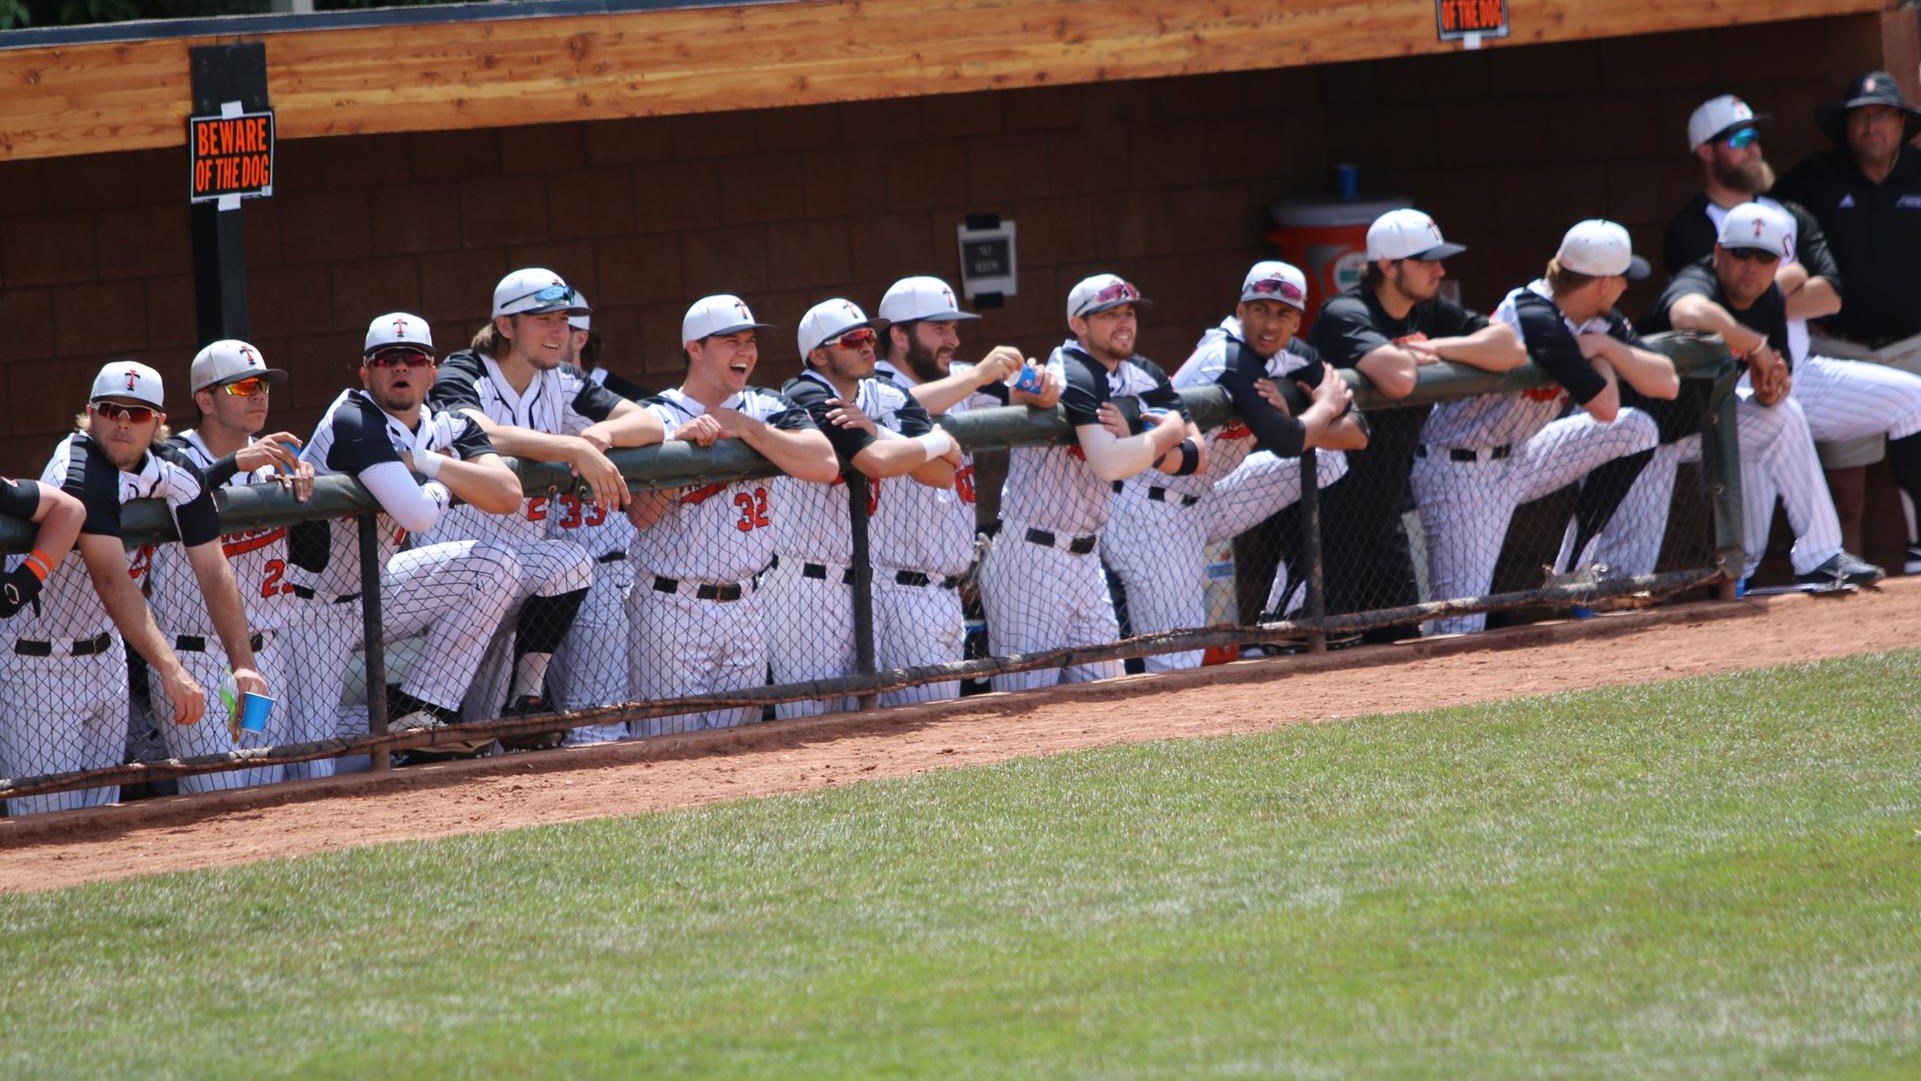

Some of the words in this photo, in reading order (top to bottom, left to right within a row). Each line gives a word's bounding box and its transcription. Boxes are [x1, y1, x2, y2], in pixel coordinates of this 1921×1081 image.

[1442, 0, 1457, 31] OF
[1458, 0, 1480, 30] THE
[1480, 0, 1503, 28] DOG
[197, 118, 267, 156] BEWARE
[196, 159, 213, 192] OF
[216, 157, 240, 190] THE
[241, 154, 269, 187] DOG
[559, 492, 608, 529] 33
[734, 486, 770, 533] 32
[261, 558, 295, 598] 2
